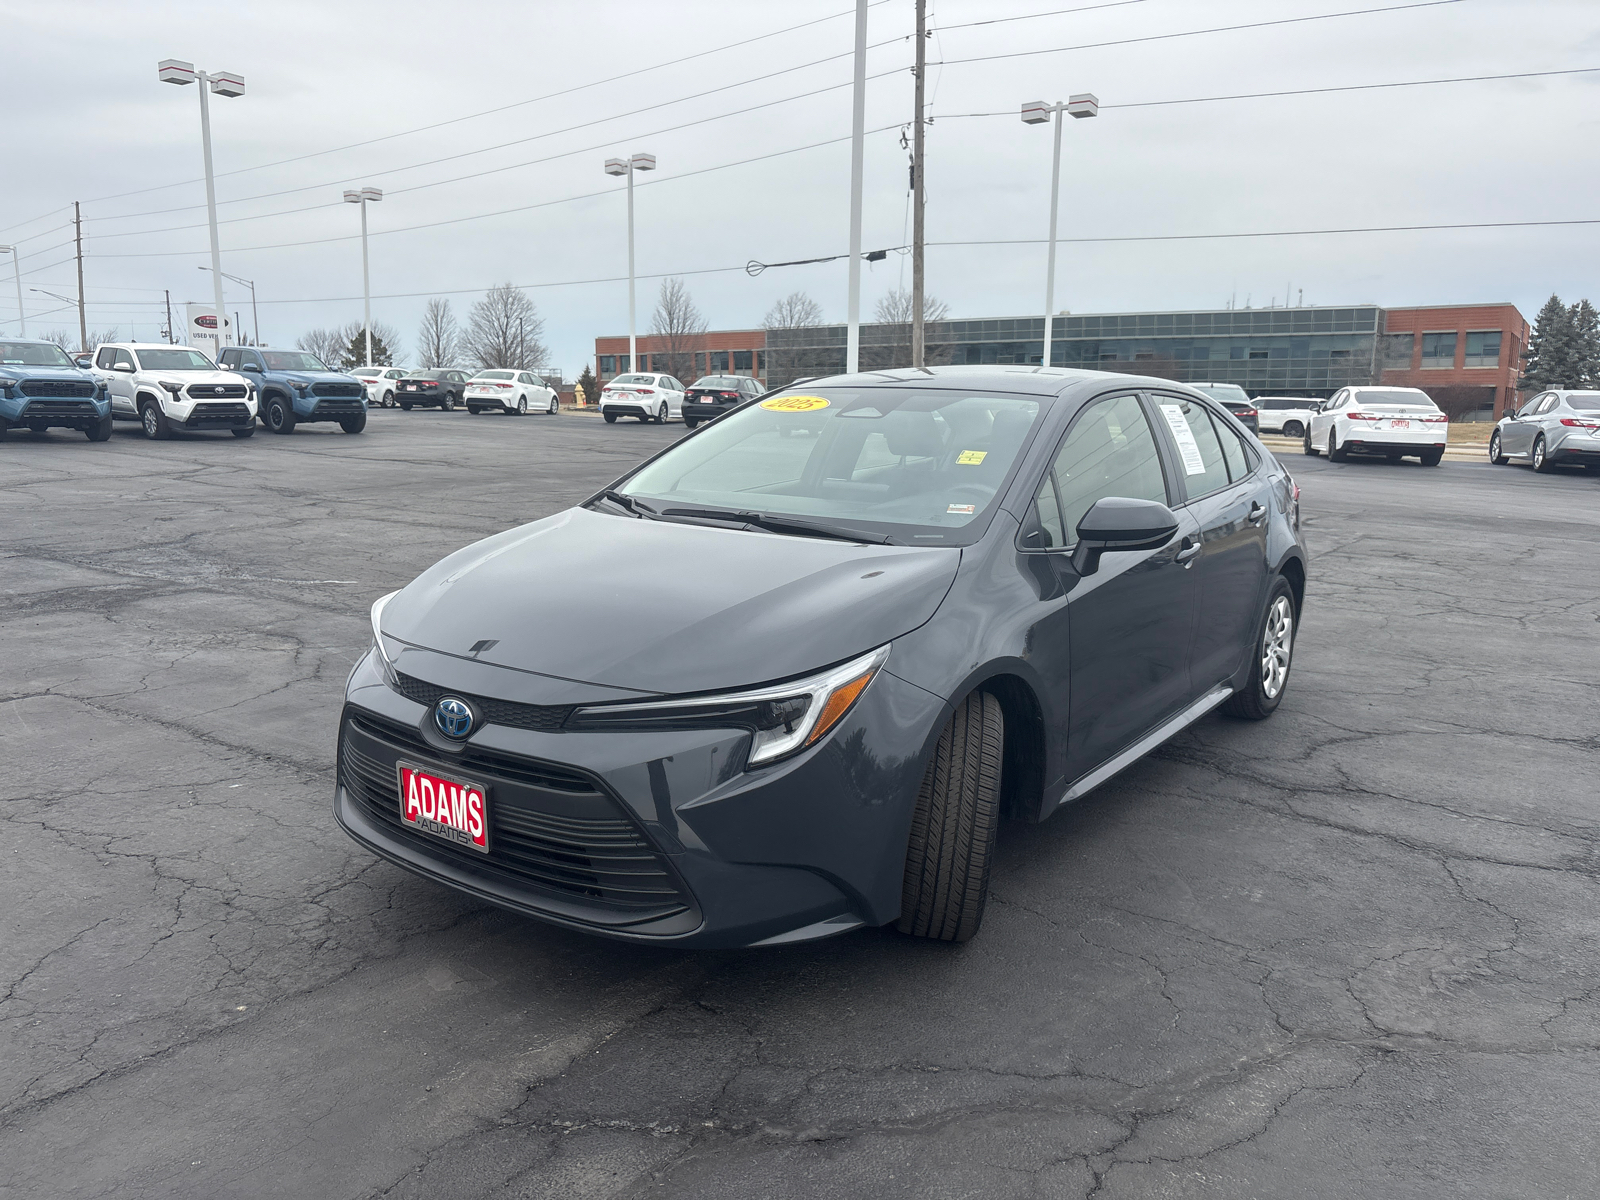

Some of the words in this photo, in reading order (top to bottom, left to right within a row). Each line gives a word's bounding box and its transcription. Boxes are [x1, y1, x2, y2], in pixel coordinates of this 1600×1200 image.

[766, 398, 823, 409] 2025
[408, 773, 483, 838] ADAMS
[421, 818, 468, 845] ADAMS
